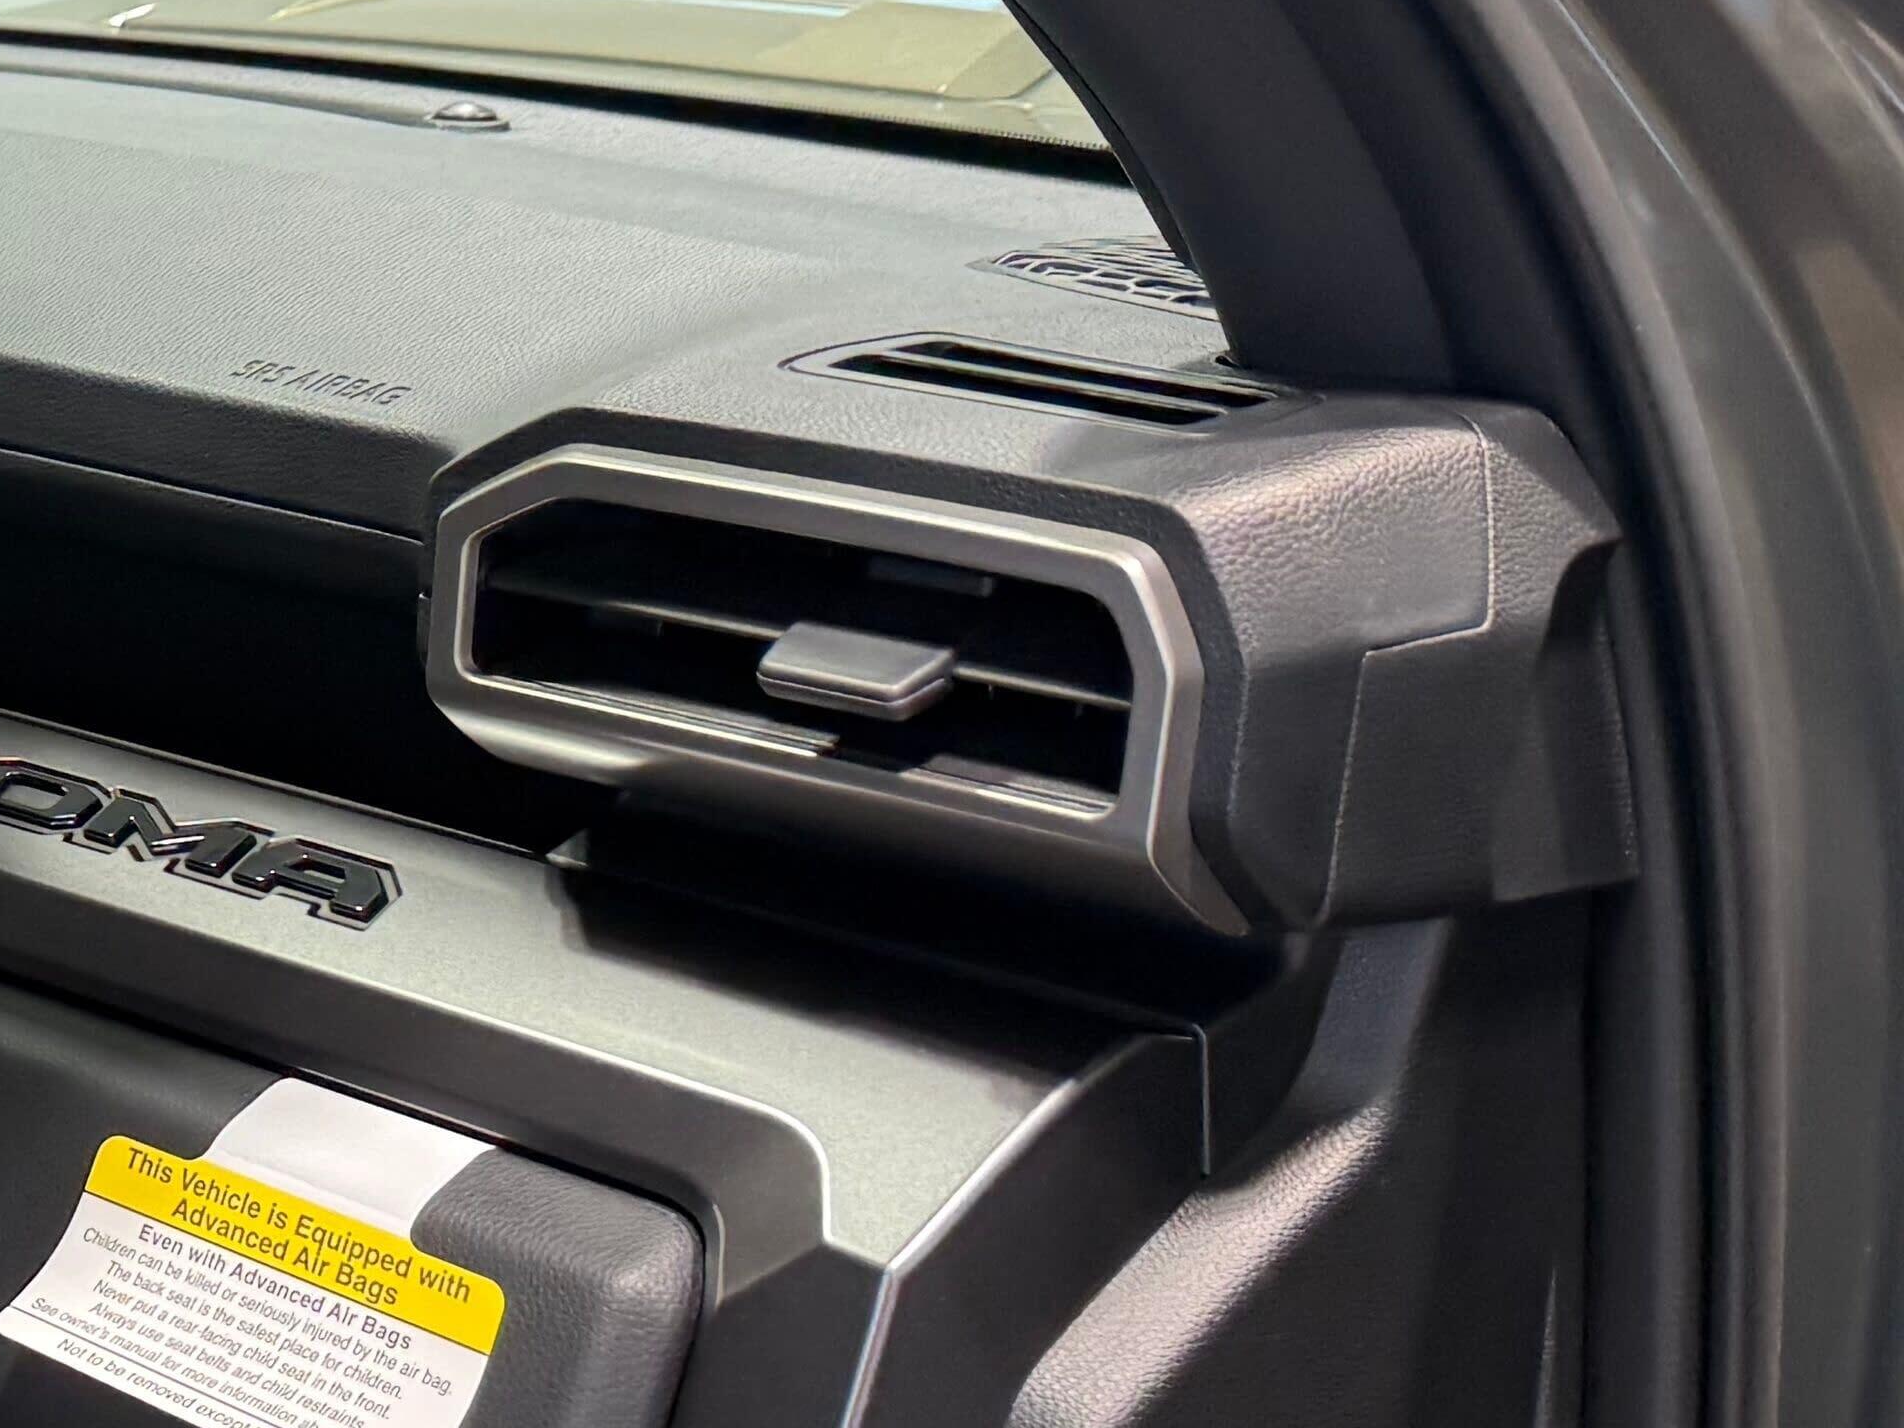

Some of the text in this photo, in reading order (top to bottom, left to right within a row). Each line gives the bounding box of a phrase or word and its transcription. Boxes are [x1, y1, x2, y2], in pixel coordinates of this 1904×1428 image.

[229, 359, 413, 405] SRS AIRBAG
[128, 1147, 471, 1304] This Vehicle is Equipped with
[138, 1224, 412, 1349] Even with Advanced Air Bags
[171, 1198, 398, 1305] Advanced Air Bags
[31, 1297, 58, 1317] See
[59, 1312, 110, 1340] owner's
[109, 1335, 163, 1363] manual
[160, 1355, 182, 1372] for
[181, 1366, 219, 1389] more
[218, 1381, 298, 1424] information
[83, 1227, 138, 1260] Children
[138, 1253, 164, 1272] can
[165, 1261, 183, 1280] be
[184, 1267, 222, 1295] killed
[221, 1287, 238, 1302] or
[238, 1294, 302, 1332] seriously
[302, 1318, 353, 1350] injured
[353, 1339, 373, 1361] by
[373, 1350, 397, 1370] the
[400, 1361, 420, 1379] air
[88, 1302, 137, 1331] Always
[137, 1325, 165, 1342] use
[164, 1337, 198, 1357] seat
[196, 1348, 232, 1372] belts
[231, 1366, 262, 1385] and
[261, 1379, 299, 1401] child
[93, 1279, 390, 1420] Never put a rear-facing child seat in the front.
[106, 1260, 402, 1399] The back seat is the safest place for children.
[57, 1338, 88, 1359] Not
[86, 1352, 104, 1366] to
[104, 1360, 127, 1377] be
[126, 1372, 198, 1409] removed
